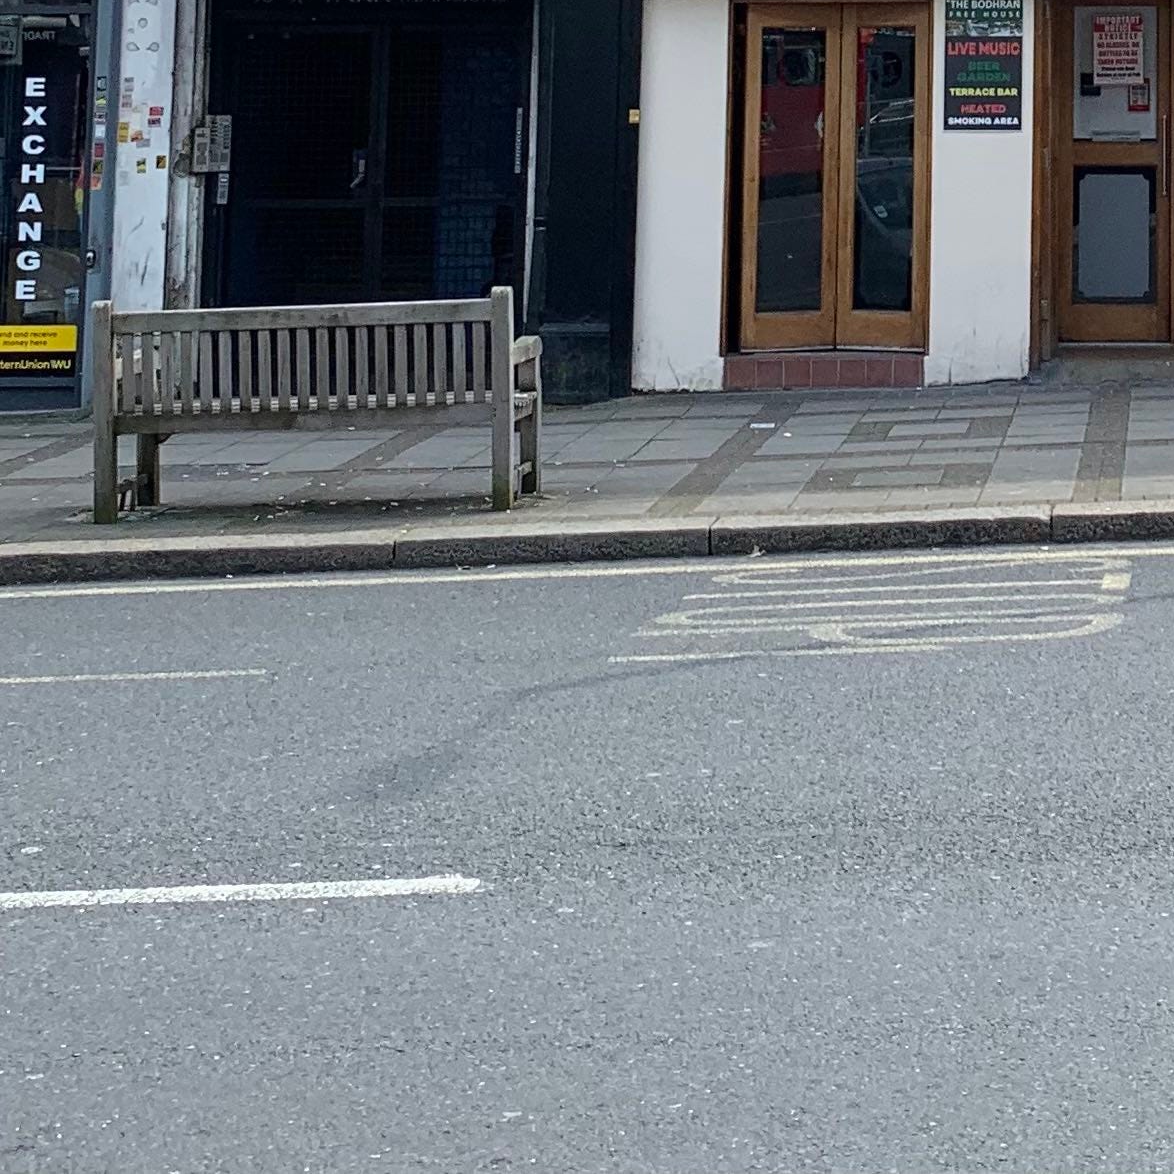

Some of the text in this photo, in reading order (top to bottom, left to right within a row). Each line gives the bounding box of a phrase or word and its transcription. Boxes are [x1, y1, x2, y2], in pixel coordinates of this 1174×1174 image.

[950, 0, 1021, 9] THE BODHRAN
[947, 41, 1021, 56] LIVE MUSIC
[949, 87, 1019, 97] TERRACE BAR
[960, 103, 1007, 114] HEATED
[948, 116, 1019, 126] SMOKING AREA
[15, 77, 47, 300] EXCHANGE
